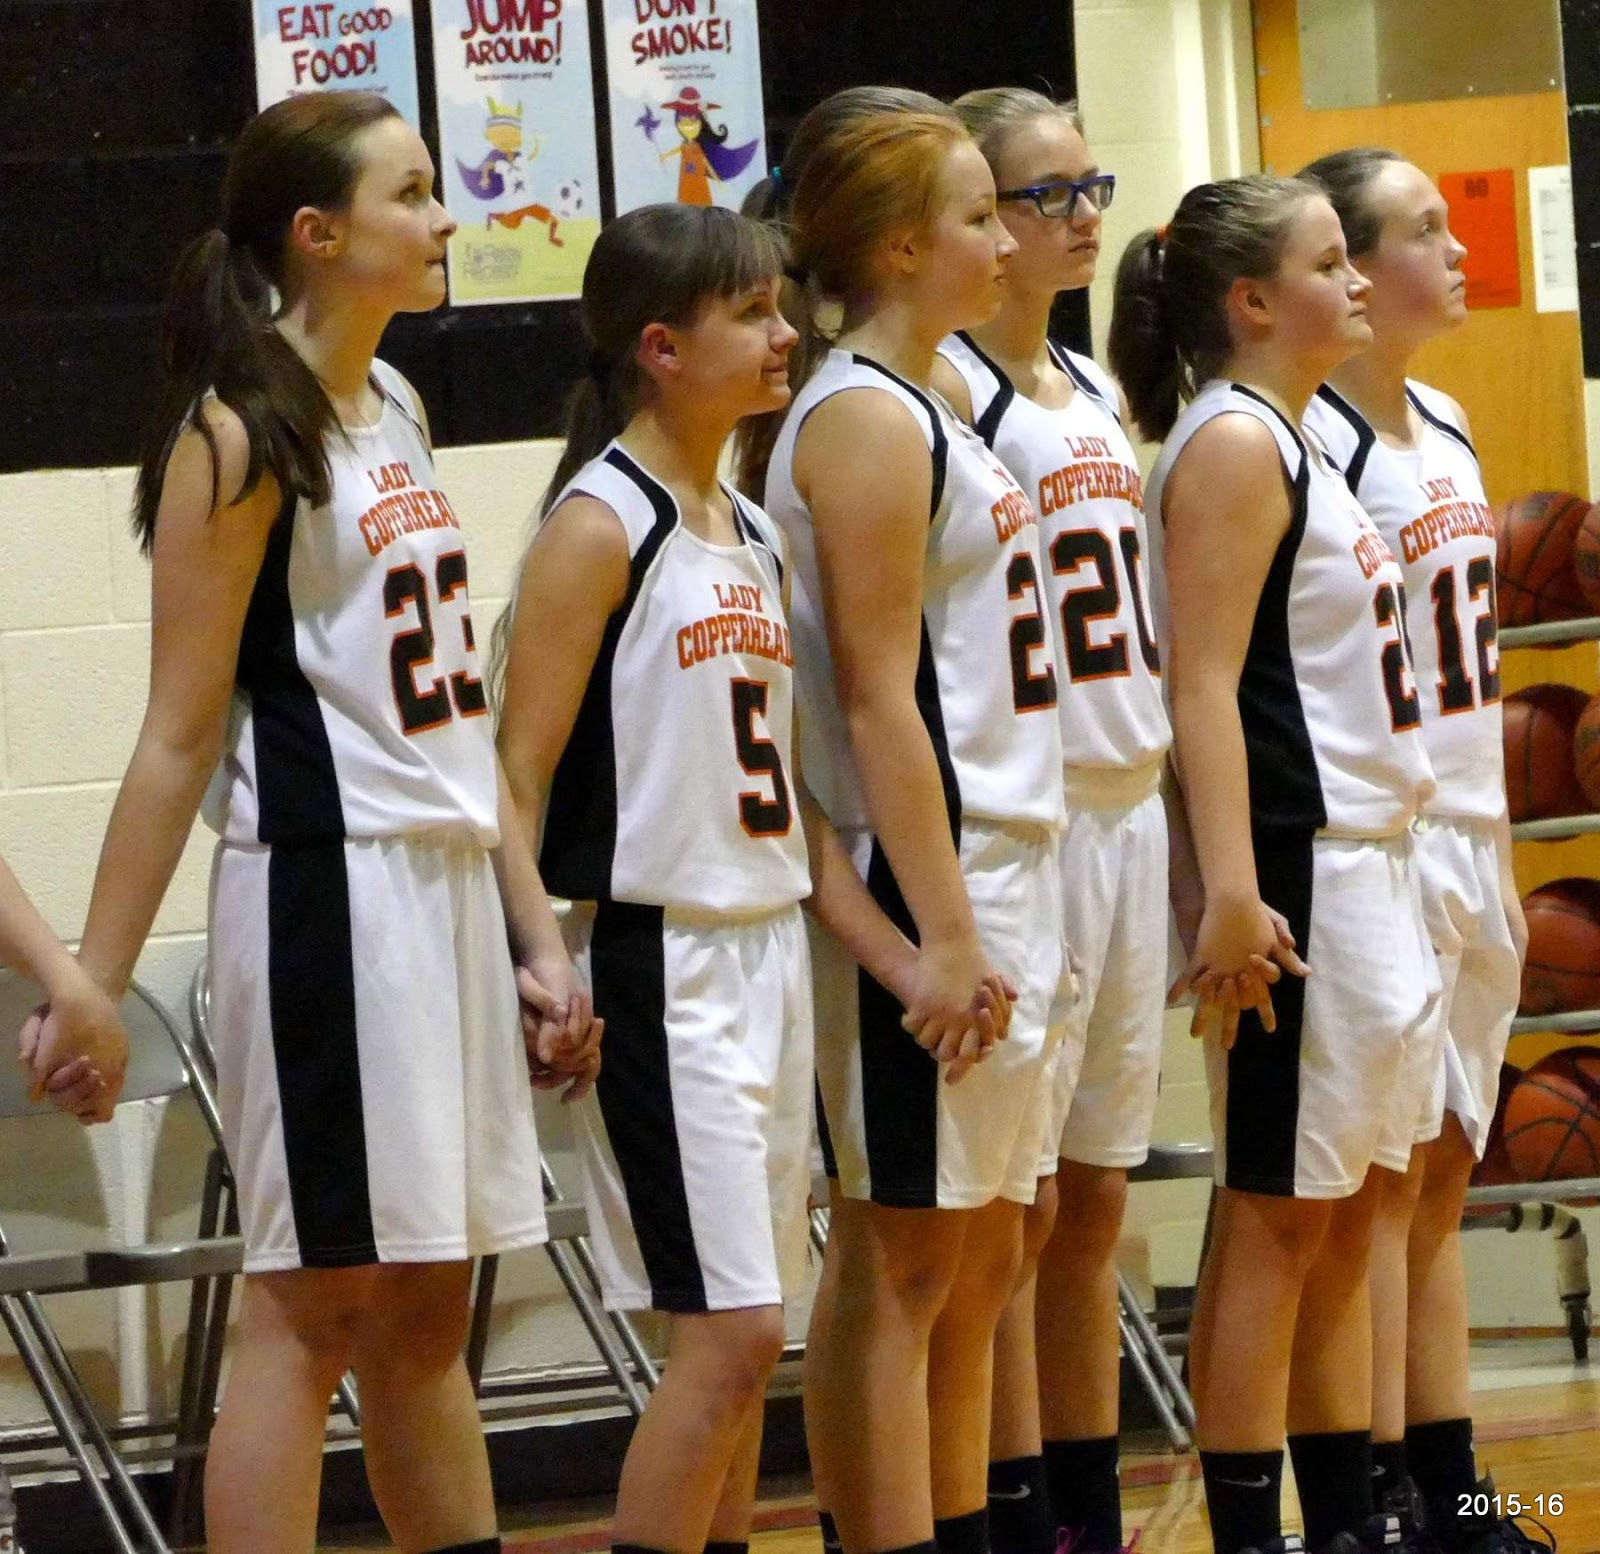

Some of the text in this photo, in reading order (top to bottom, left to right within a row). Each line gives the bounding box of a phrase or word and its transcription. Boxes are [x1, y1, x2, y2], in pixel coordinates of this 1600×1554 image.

[278, 3, 392, 42] EAT GOOD
[460, 0, 562, 40] JUMP
[634, 0, 717, 24] DON
[465, 21, 562, 68] AROUND!
[631, 18, 732, 65] SMOKE!
[292, 40, 377, 84] FOOD!
[1064, 436, 1113, 459] LADY
[367, 461, 416, 494] LADY
[1420, 476, 1460, 503] LADY
[712, 583, 763, 612] LADY
[1430, 555, 1502, 716] 12
[730, 676, 793, 838] 5
